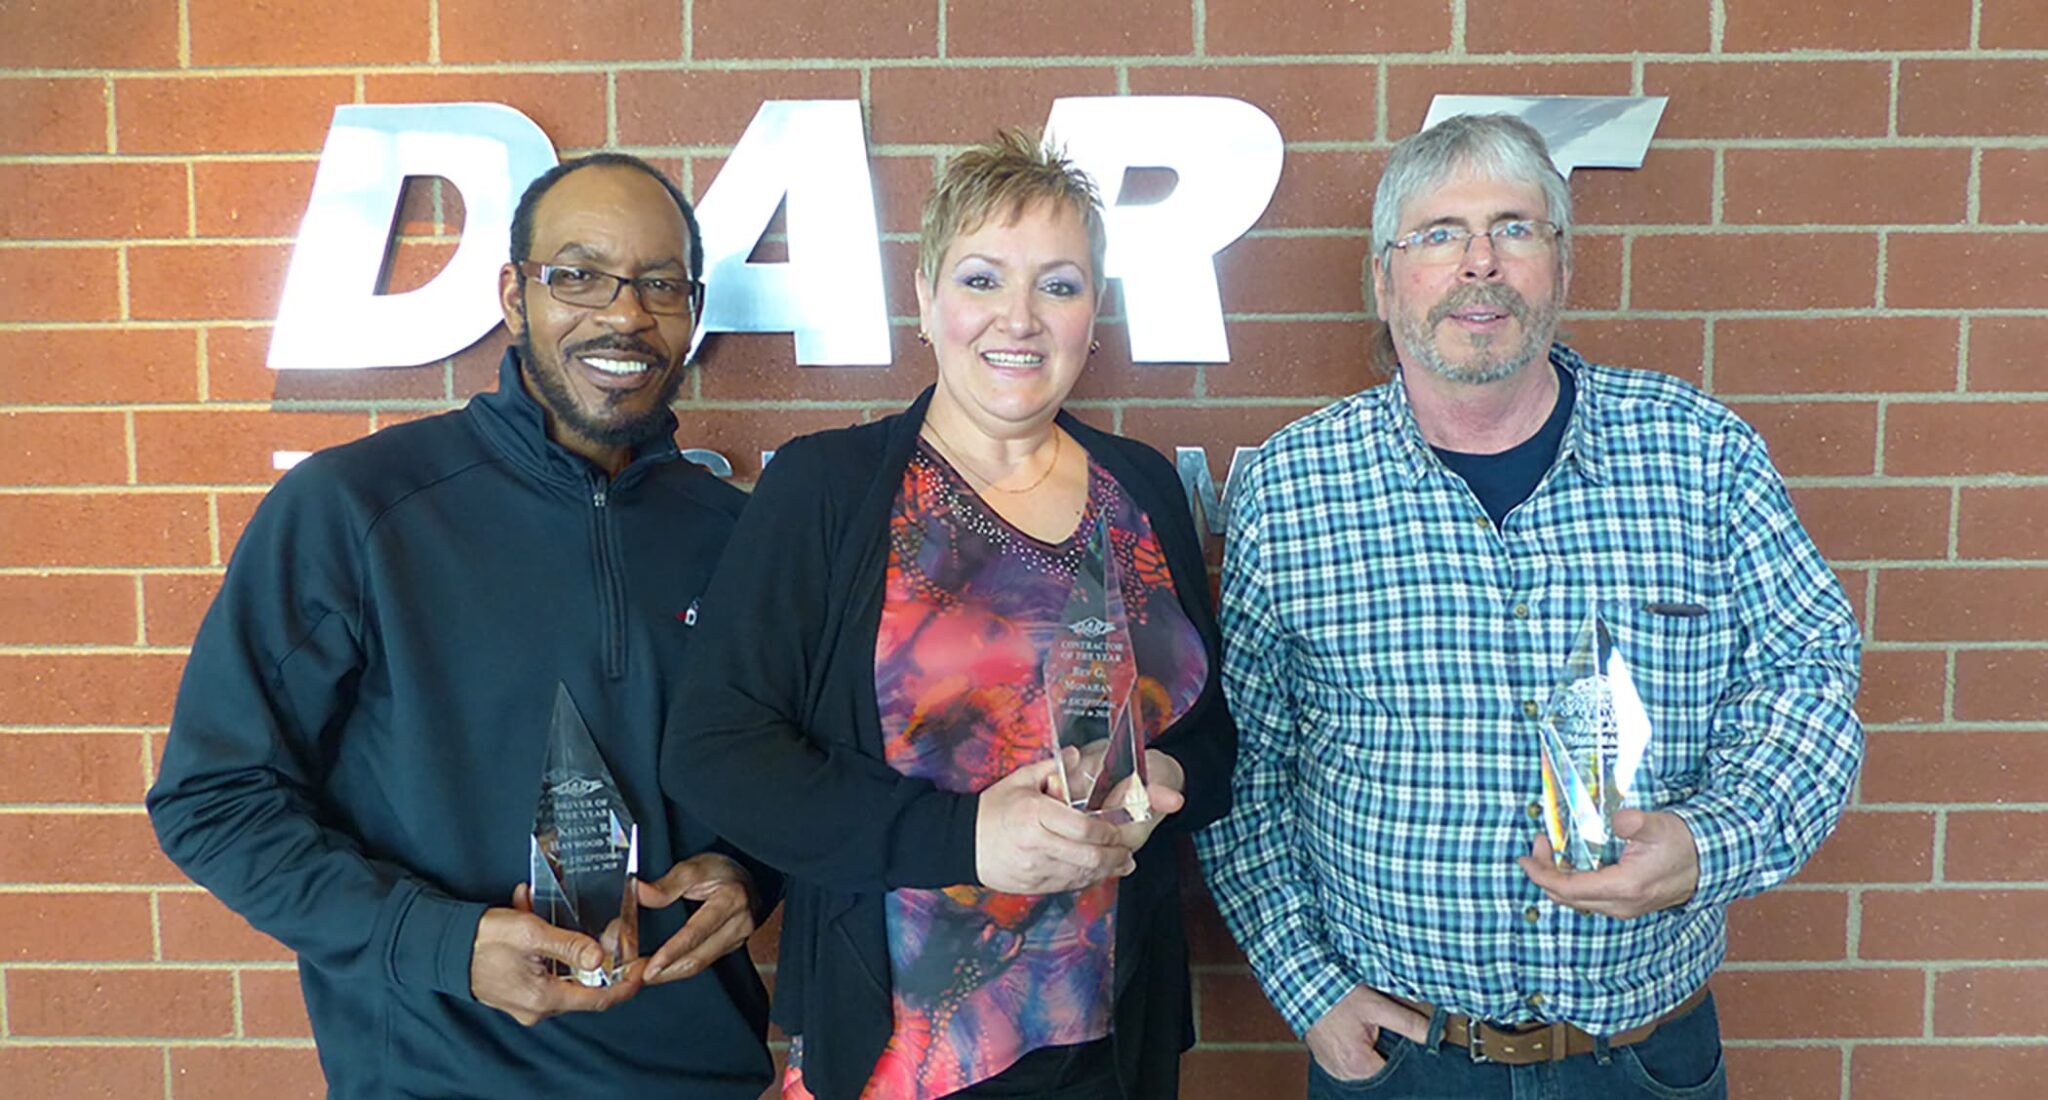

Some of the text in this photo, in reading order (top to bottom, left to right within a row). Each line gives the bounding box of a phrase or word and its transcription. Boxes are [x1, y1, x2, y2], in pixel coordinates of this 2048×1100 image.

[1061, 641, 1123, 651] CONTRACTOR
[1060, 652, 1122, 663] OF THE YEAR
[594, 799, 608, 807] OF
[580, 808, 608, 818] YEAR
